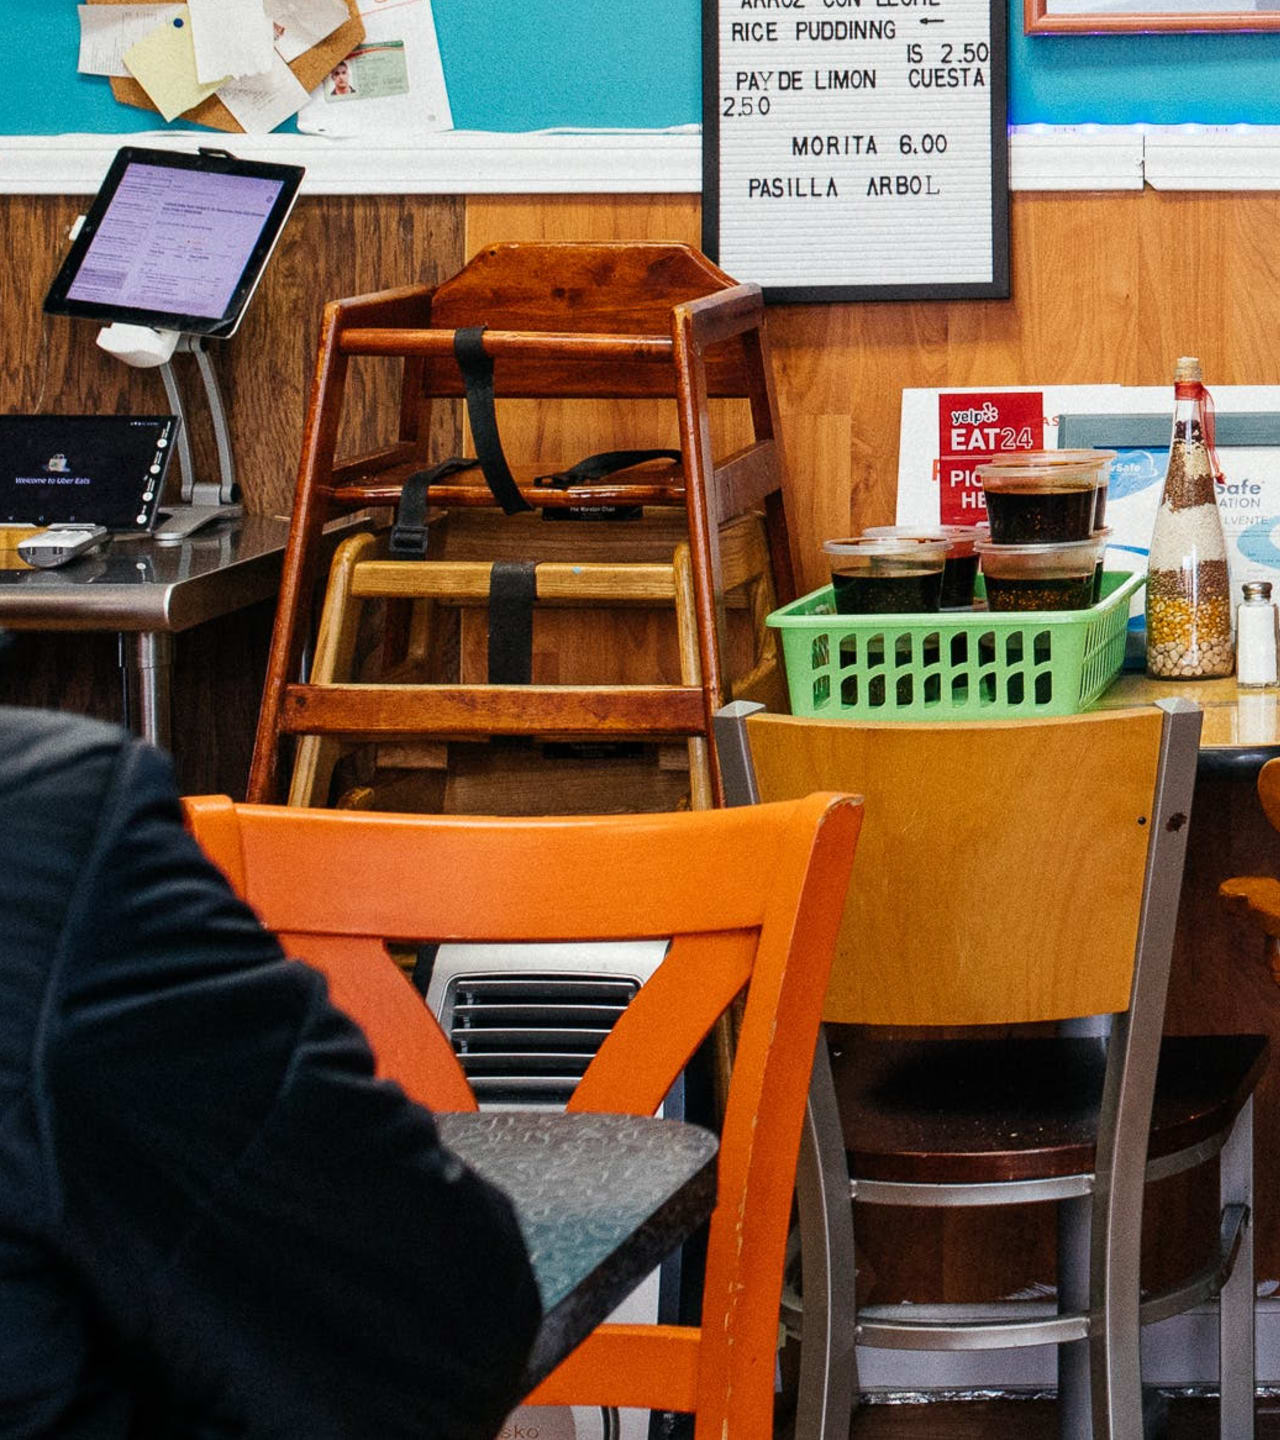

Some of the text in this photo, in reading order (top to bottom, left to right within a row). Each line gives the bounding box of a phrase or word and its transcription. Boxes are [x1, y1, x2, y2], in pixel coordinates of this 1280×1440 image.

[731, 20, 896, 42] RICE PUDDINNG
[907, 42, 989, 63] IS 2.50
[815, 70, 876, 89] LIMON
[909, 68, 985, 87] CUESTA
[792, 134, 947, 155] MORITA 6.00
[750, 175, 940, 198] PASILLA ARBOL
[951, 409, 983, 426] yelp
[951, 427, 1034, 451] EAT24
[15, 477, 91, 485] Welcome to Uber Eats
[950, 470, 984, 487] PIC
[1216, 479, 1261, 495] Safe
[1219, 497, 1260, 508] ATION
[1225, 516, 1268, 525] LVENTE
[500, 1425, 539, 1439] sko
